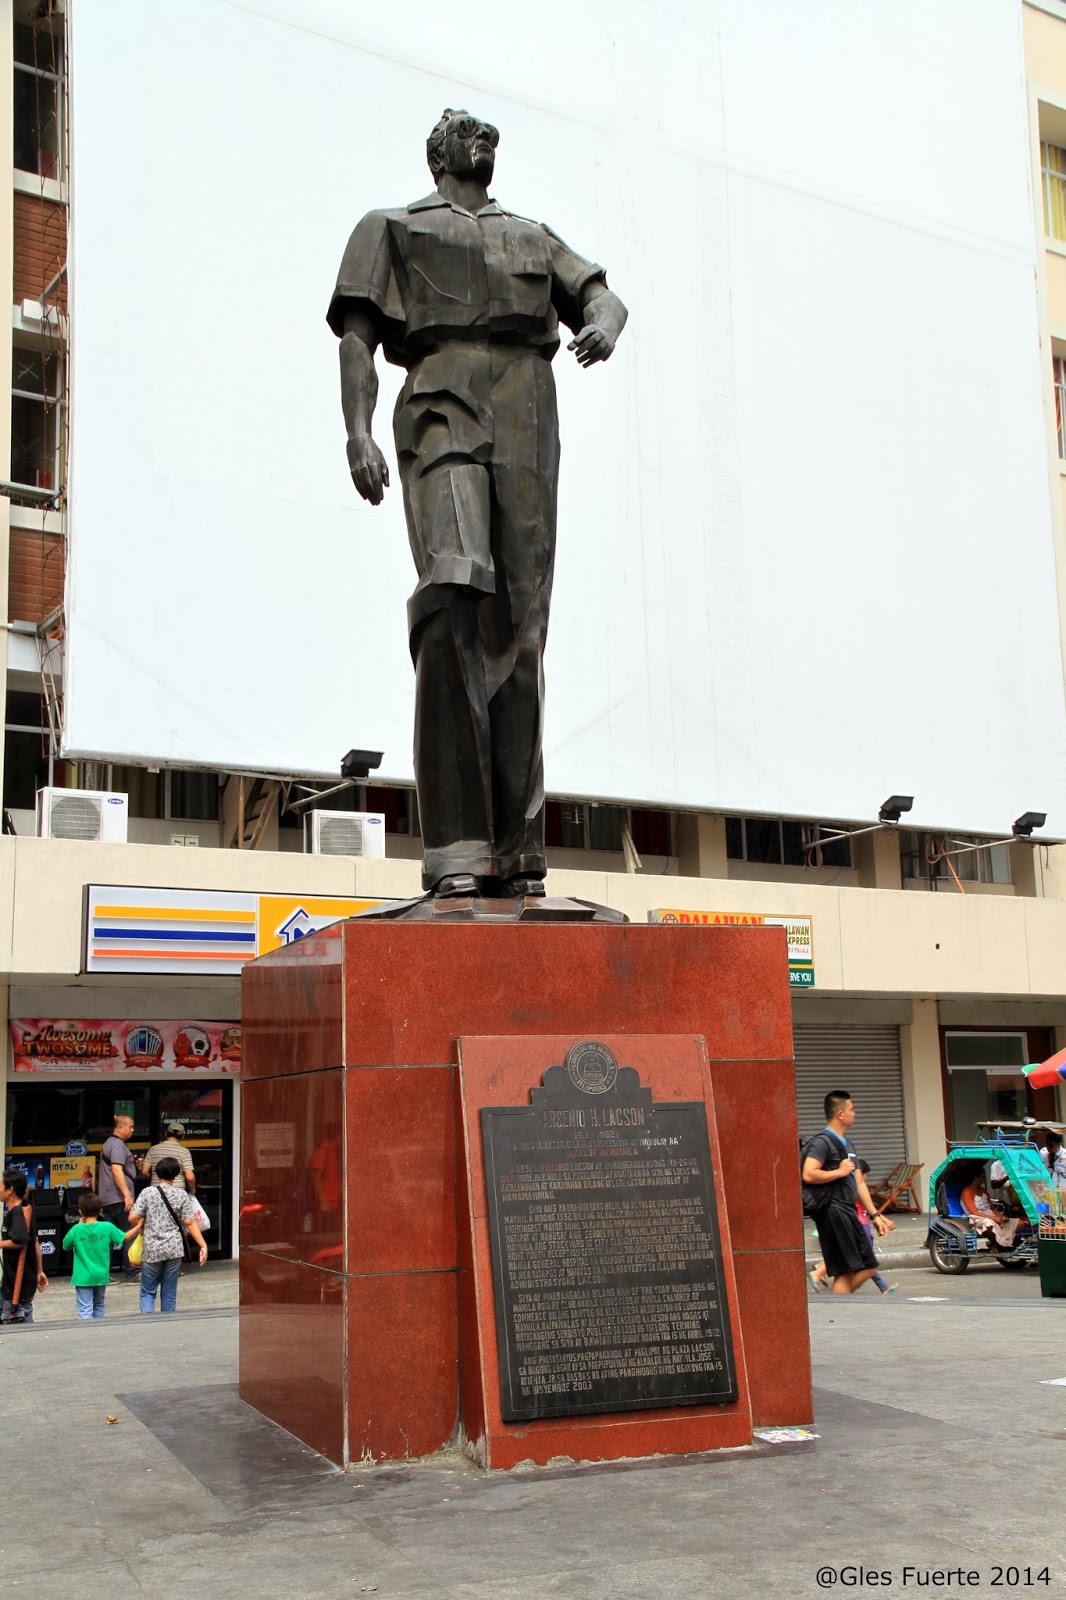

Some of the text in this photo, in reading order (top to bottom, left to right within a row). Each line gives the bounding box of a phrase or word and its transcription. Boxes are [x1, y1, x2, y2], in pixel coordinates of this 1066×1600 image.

[786, 925, 809, 936] LAWAN
[788, 937, 809, 945] XPRESS
[801, 973, 811, 982] YOU
[23, 1025, 111, 1041] Awesome
[576, 1080, 607, 1093] PILIPINAS
[542, 1109, 586, 1129] ARSENIO
[602, 1107, 645, 1127] LACSON
[52, 1163, 78, 1171] MEAL!
[529, 1205, 542, 1214] SIYA
[557, 1213, 572, 1221] 1952
[543, 1223, 563, 1232] MAYOR
[548, 1240, 585, 1250] STOCKYARD
[594, 1238, 608, 1247] CITY
[547, 1249, 580, 1258] RECEPTION
[655, 1243, 688, 1252] UNDERPASS
[532, 1259, 561, 1269] GENERAL
[562, 1257, 589, 1267] HOSPITAL
[518, 1294, 533, 1303] SIYA
[640, 1286, 653, 1295] THE
[654, 1285, 670, 1294] YEAR
[692, 1283, 706, 1292] 1956
[513, 1312, 547, 1323] COMMERCE
[556, 1328, 585, 1339] SERBISYO
[560, 1339, 575, 1348] SIYA
[671, 1345, 690, 1354] PLAZA
[691, 1343, 715, 1353] LACSON
[552, 1363, 571, 1373] LUGAR
[697, 1352, 712, 1362] JOSE
[532, 1382, 570, 1395] DISYEMBRE
